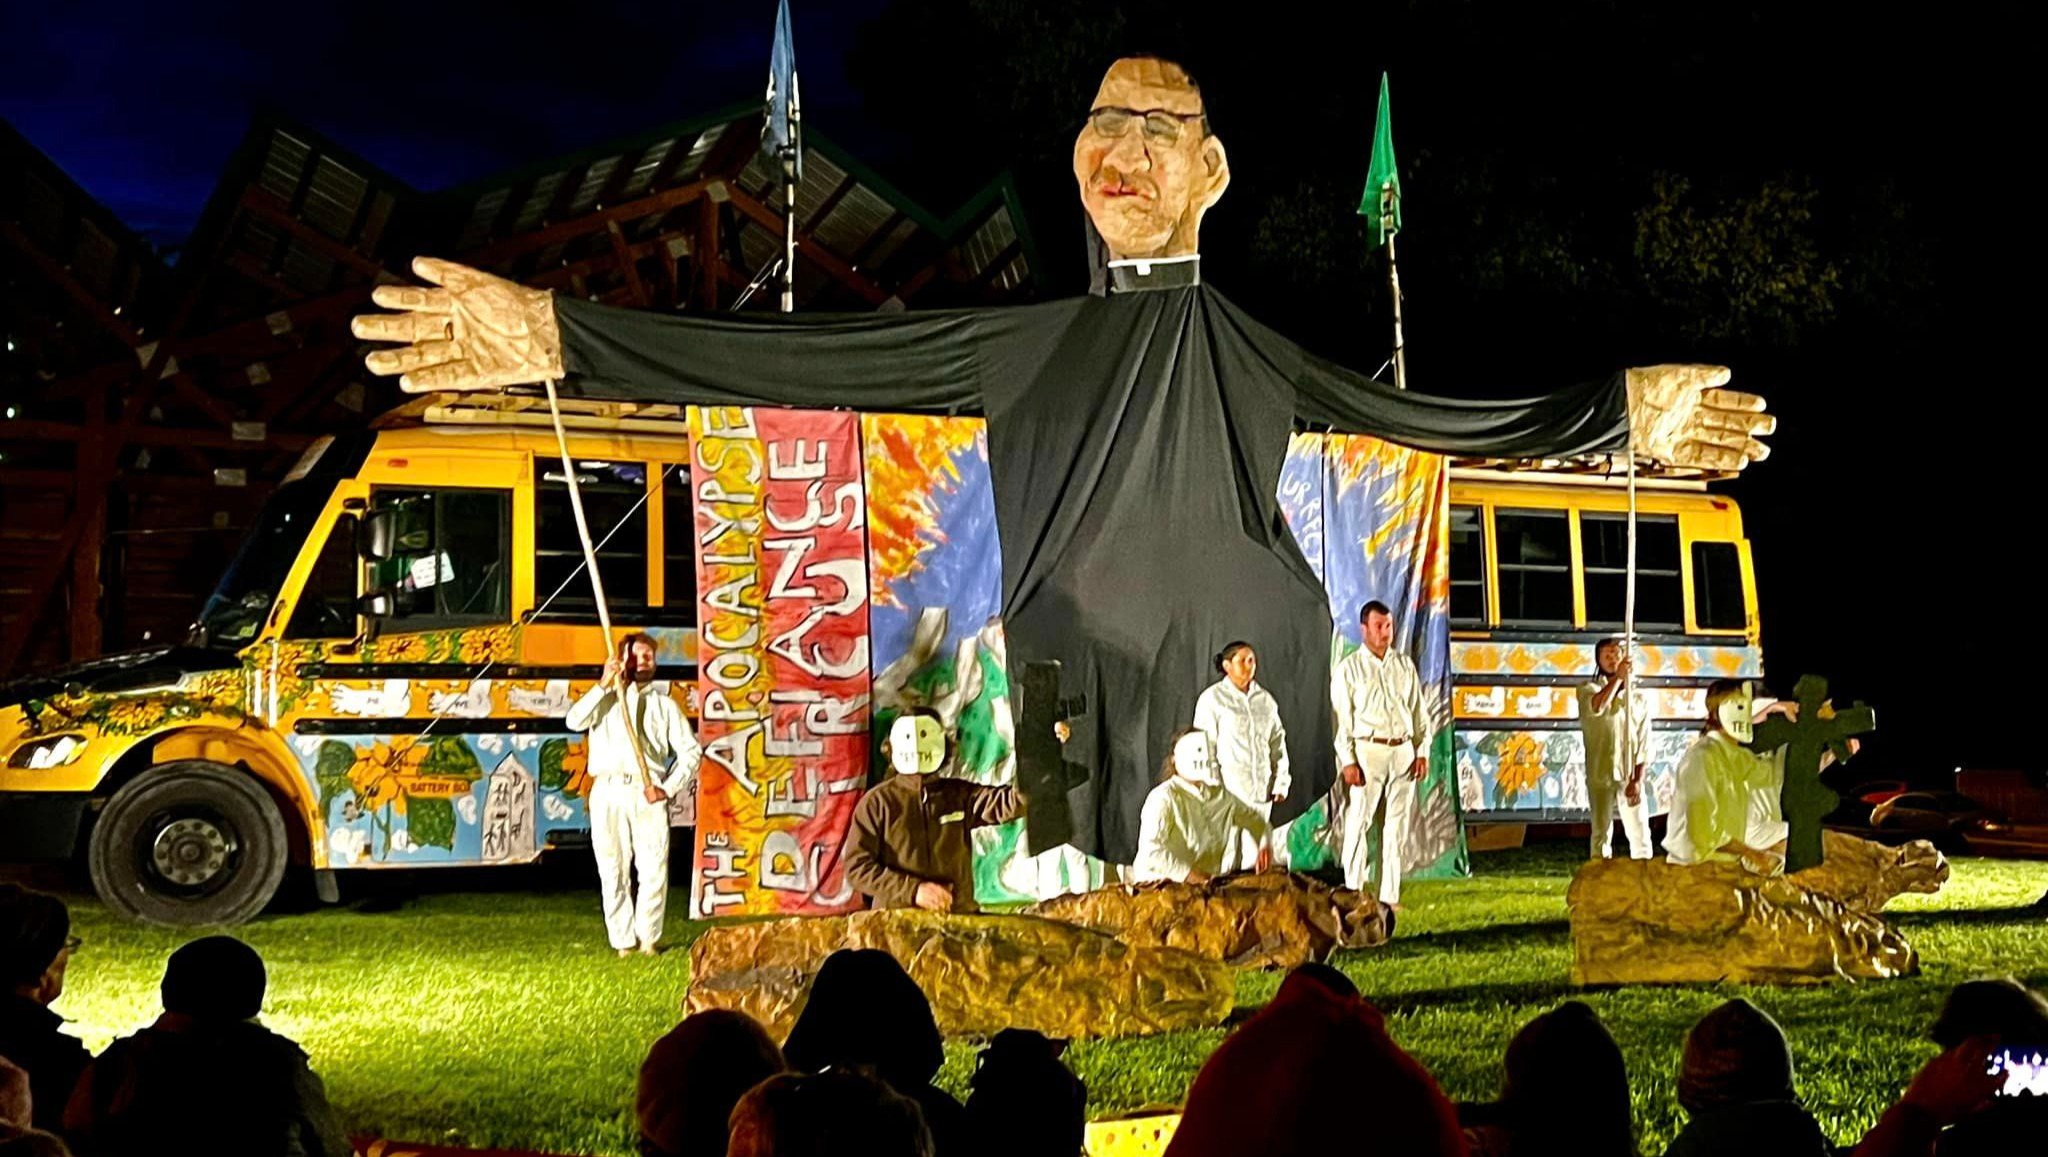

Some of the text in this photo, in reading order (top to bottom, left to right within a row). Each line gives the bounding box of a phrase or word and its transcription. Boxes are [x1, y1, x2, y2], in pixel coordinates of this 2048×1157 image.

[411, 782, 450, 793] BATTERY
[697, 407, 764, 915] THE APOCALYPSE
